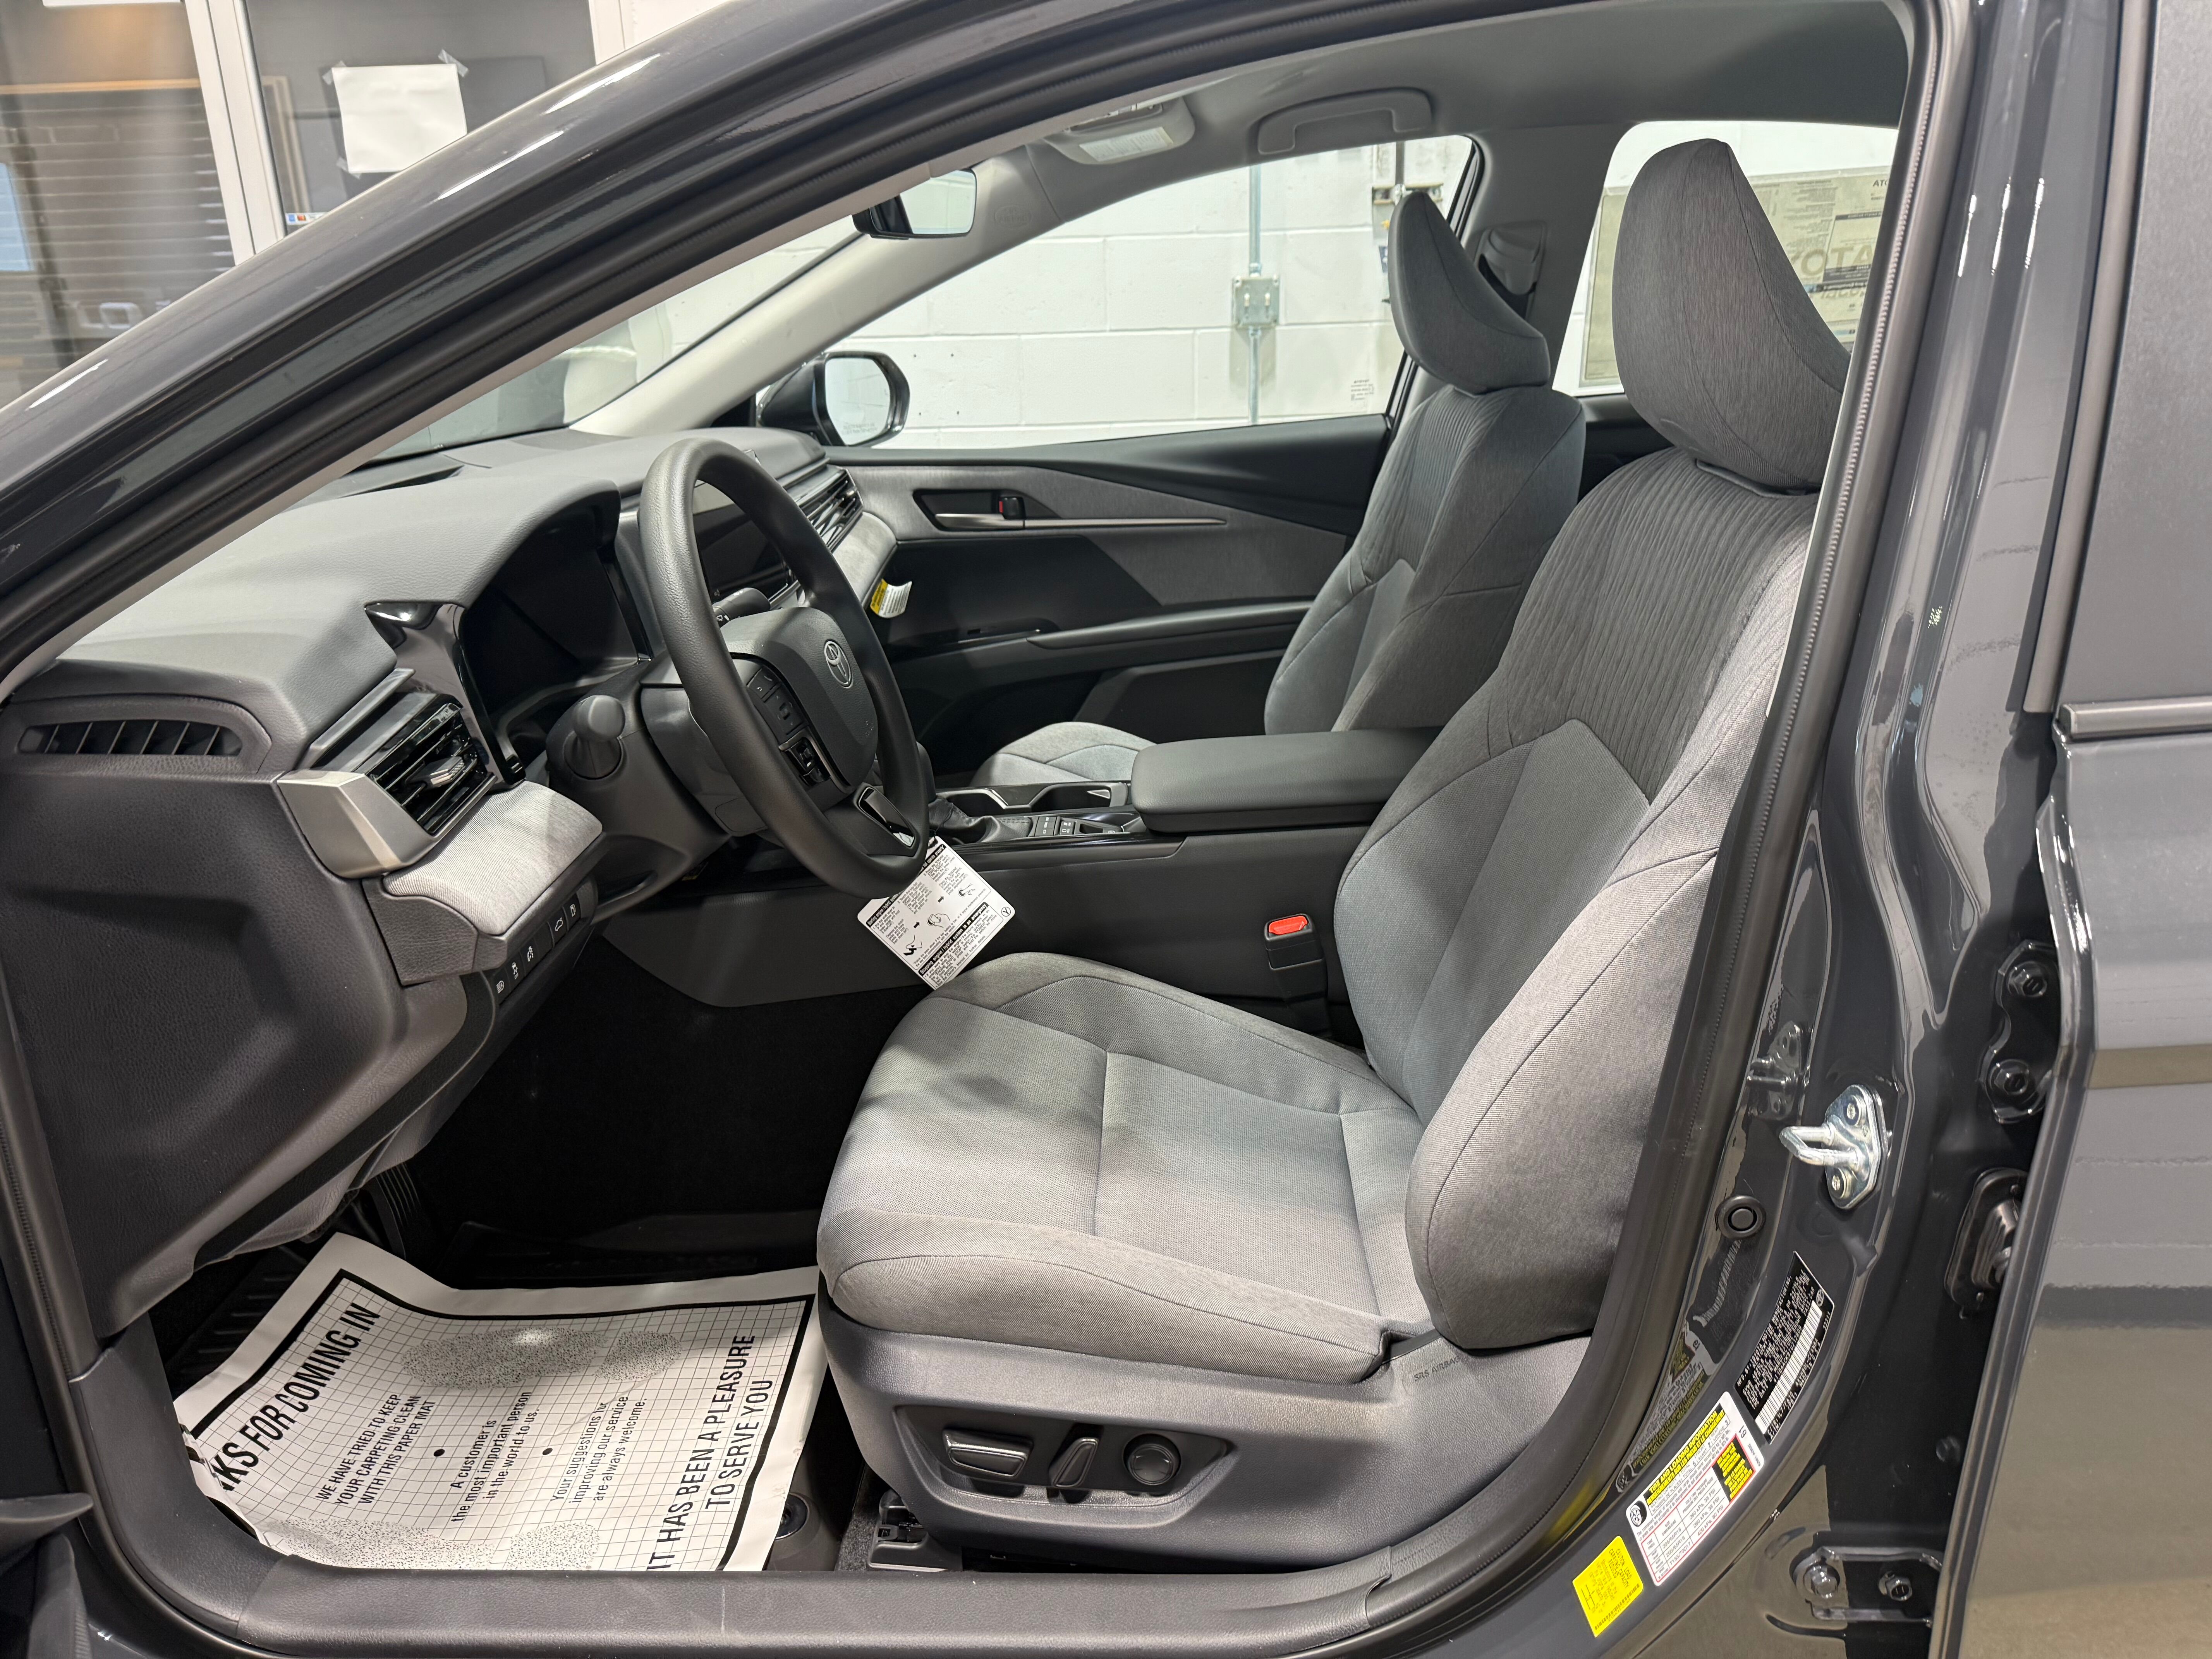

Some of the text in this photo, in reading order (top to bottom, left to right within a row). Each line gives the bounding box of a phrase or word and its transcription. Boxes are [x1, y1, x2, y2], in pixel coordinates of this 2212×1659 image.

[919, 960, 934, 975] Stopping
[951, 928, 965, 940] system
[970, 903, 988, 921] emergency
[239, 1405, 296, 1451] FOR
[275, 1330, 362, 1413] COMING
[340, 1303, 381, 1331] IN
[1413, 1356, 1459, 1381] SRS AIRBAG
[1759, 1382, 1769, 1398] DATE
[315, 1394, 401, 1500] WE HAVE TRIED TO KEEP
[334, 1396, 421, 1504] YOUR CARPETING CLEAN
[359, 1400, 436, 1503] WITH THIS PAPER MAT
[451, 1392, 532, 1522] the most important person
[458, 1430, 490, 1478] customer
[483, 1409, 539, 1499] in the world to us.
[550, 1478, 572, 1501] Your
[566, 1415, 601, 1475] suggestions
[568, 1397, 628, 1503] improving our service
[593, 1398, 647, 1501] are always welcome.
[646, 1336, 756, 1570] IT HAS BEEN A PLEASURE
[705, 1380, 773, 1509] TO SERVE YOU
[1649, 1410, 1718, 1494] TIRE AND LOADING INFORMATION
[1673, 1463, 1681, 1475] SUR
[1685, 1444, 1697, 1460] PNEUS
[1695, 1439, 1702, 1448] ET
[1700, 1434, 1706, 1443] LE
[1703, 1409, 1726, 1438] CHARGEMENT
[1738, 1424, 1748, 1439] 61
[1670, 1479, 1681, 1494] PLACES
[1683, 1466, 1692, 1479] TOTAL
[1618, 1568, 1629, 1589] CAPACITY
